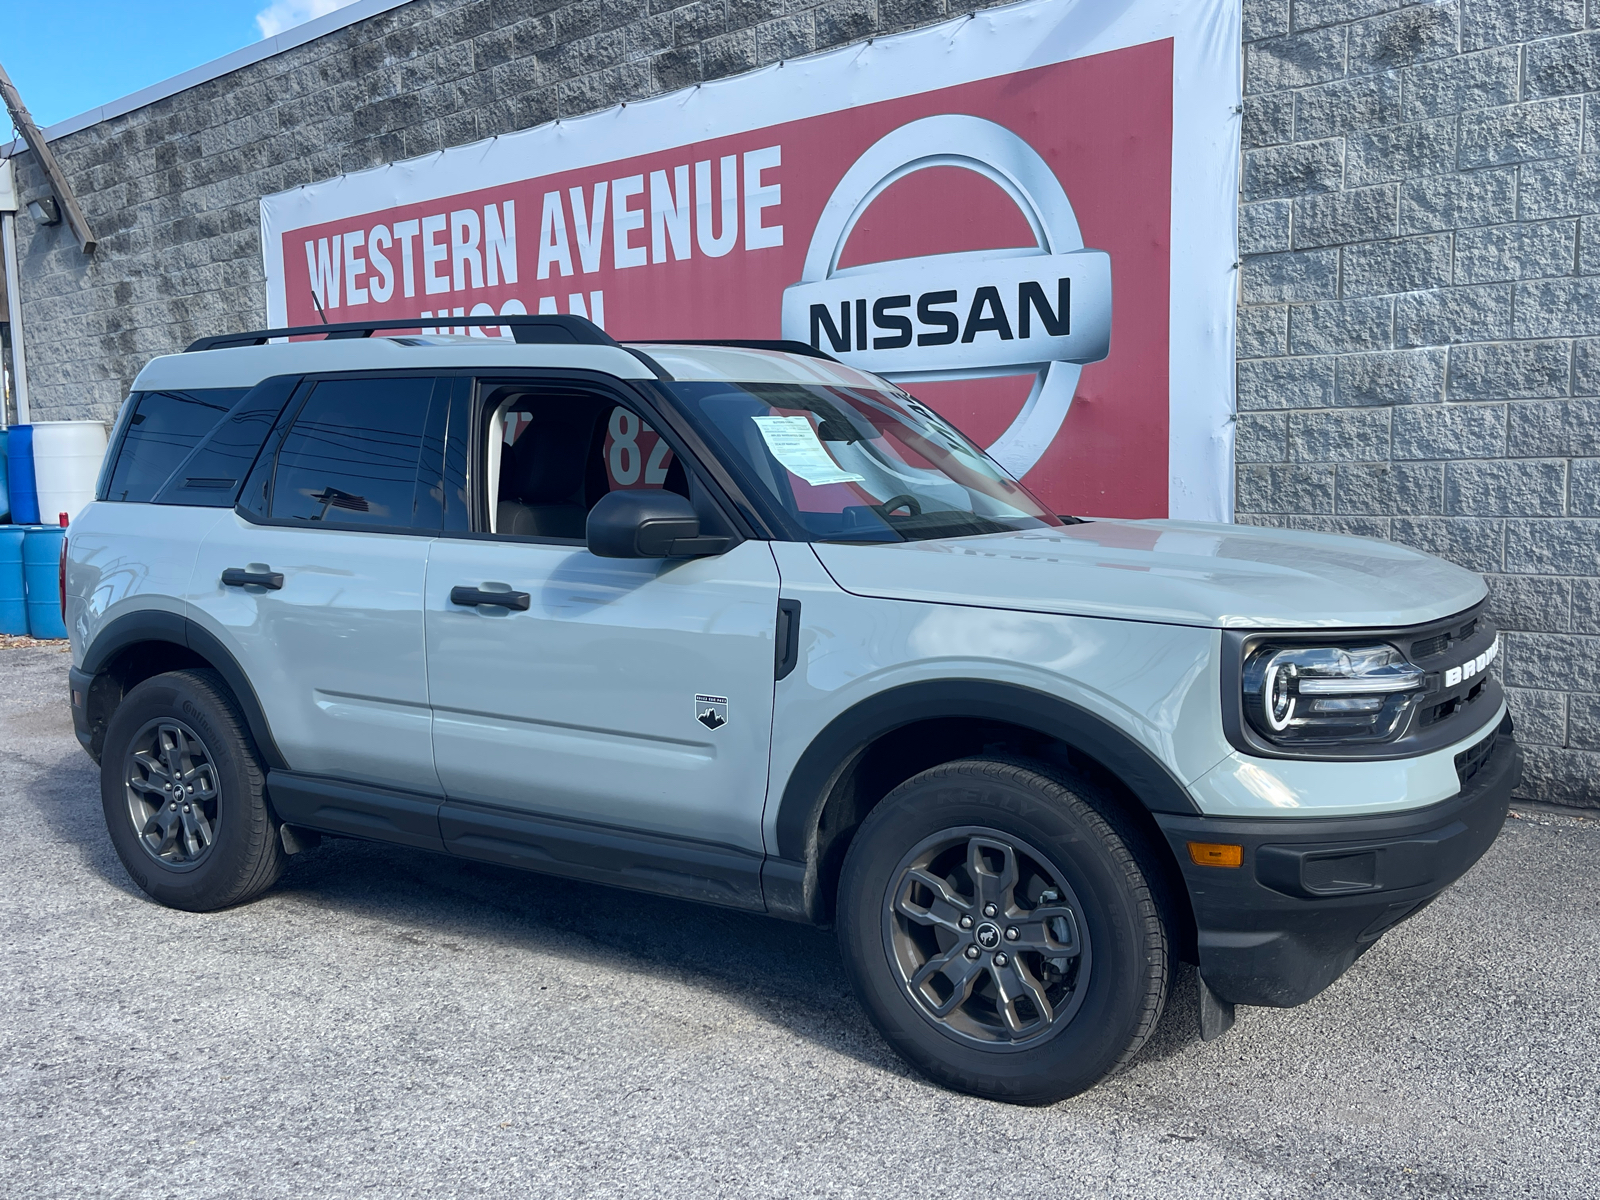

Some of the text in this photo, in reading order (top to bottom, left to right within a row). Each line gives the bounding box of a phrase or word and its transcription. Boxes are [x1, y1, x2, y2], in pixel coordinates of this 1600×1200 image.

[305, 145, 784, 310] WESTERN AVENUE
[810, 277, 1070, 352] NISSAN
[1445, 634, 1498, 688] BRONC
[182, 700, 227, 757] Continental
[937, 787, 1040, 817] KELLY
[1107, 903, 1127, 953] EDGE
